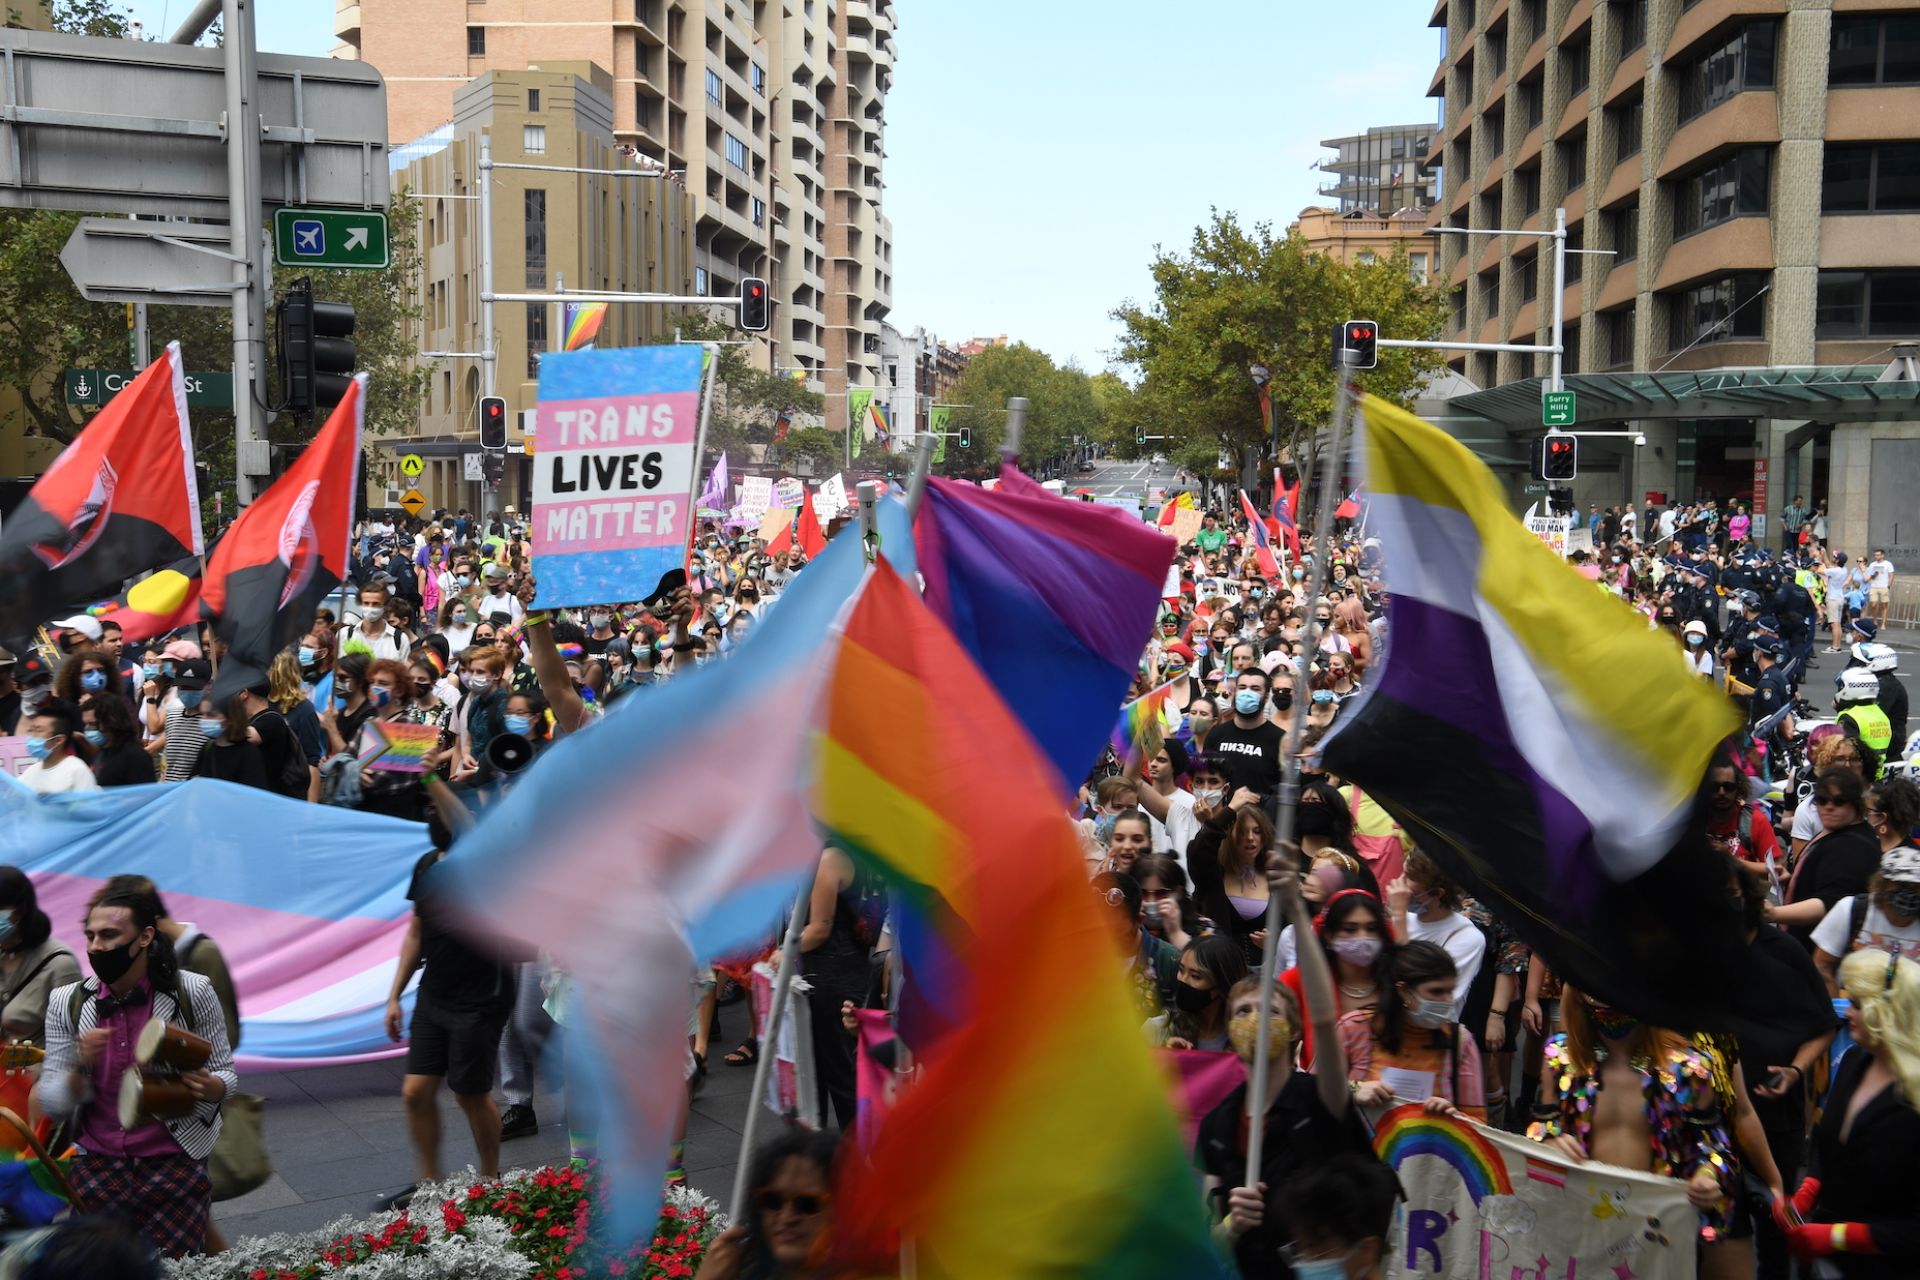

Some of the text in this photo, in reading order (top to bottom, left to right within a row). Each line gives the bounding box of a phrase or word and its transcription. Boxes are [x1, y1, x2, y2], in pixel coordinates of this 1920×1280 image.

[184, 376, 203, 393] St
[1548, 395, 1570, 404] Surry
[1550, 403, 1568, 411] Hills
[555, 403, 674, 446] TRANS
[552, 451, 663, 494] LIVES
[546, 500, 677, 543] MATTER
[1219, 742, 1262, 757] ПИЗДА
